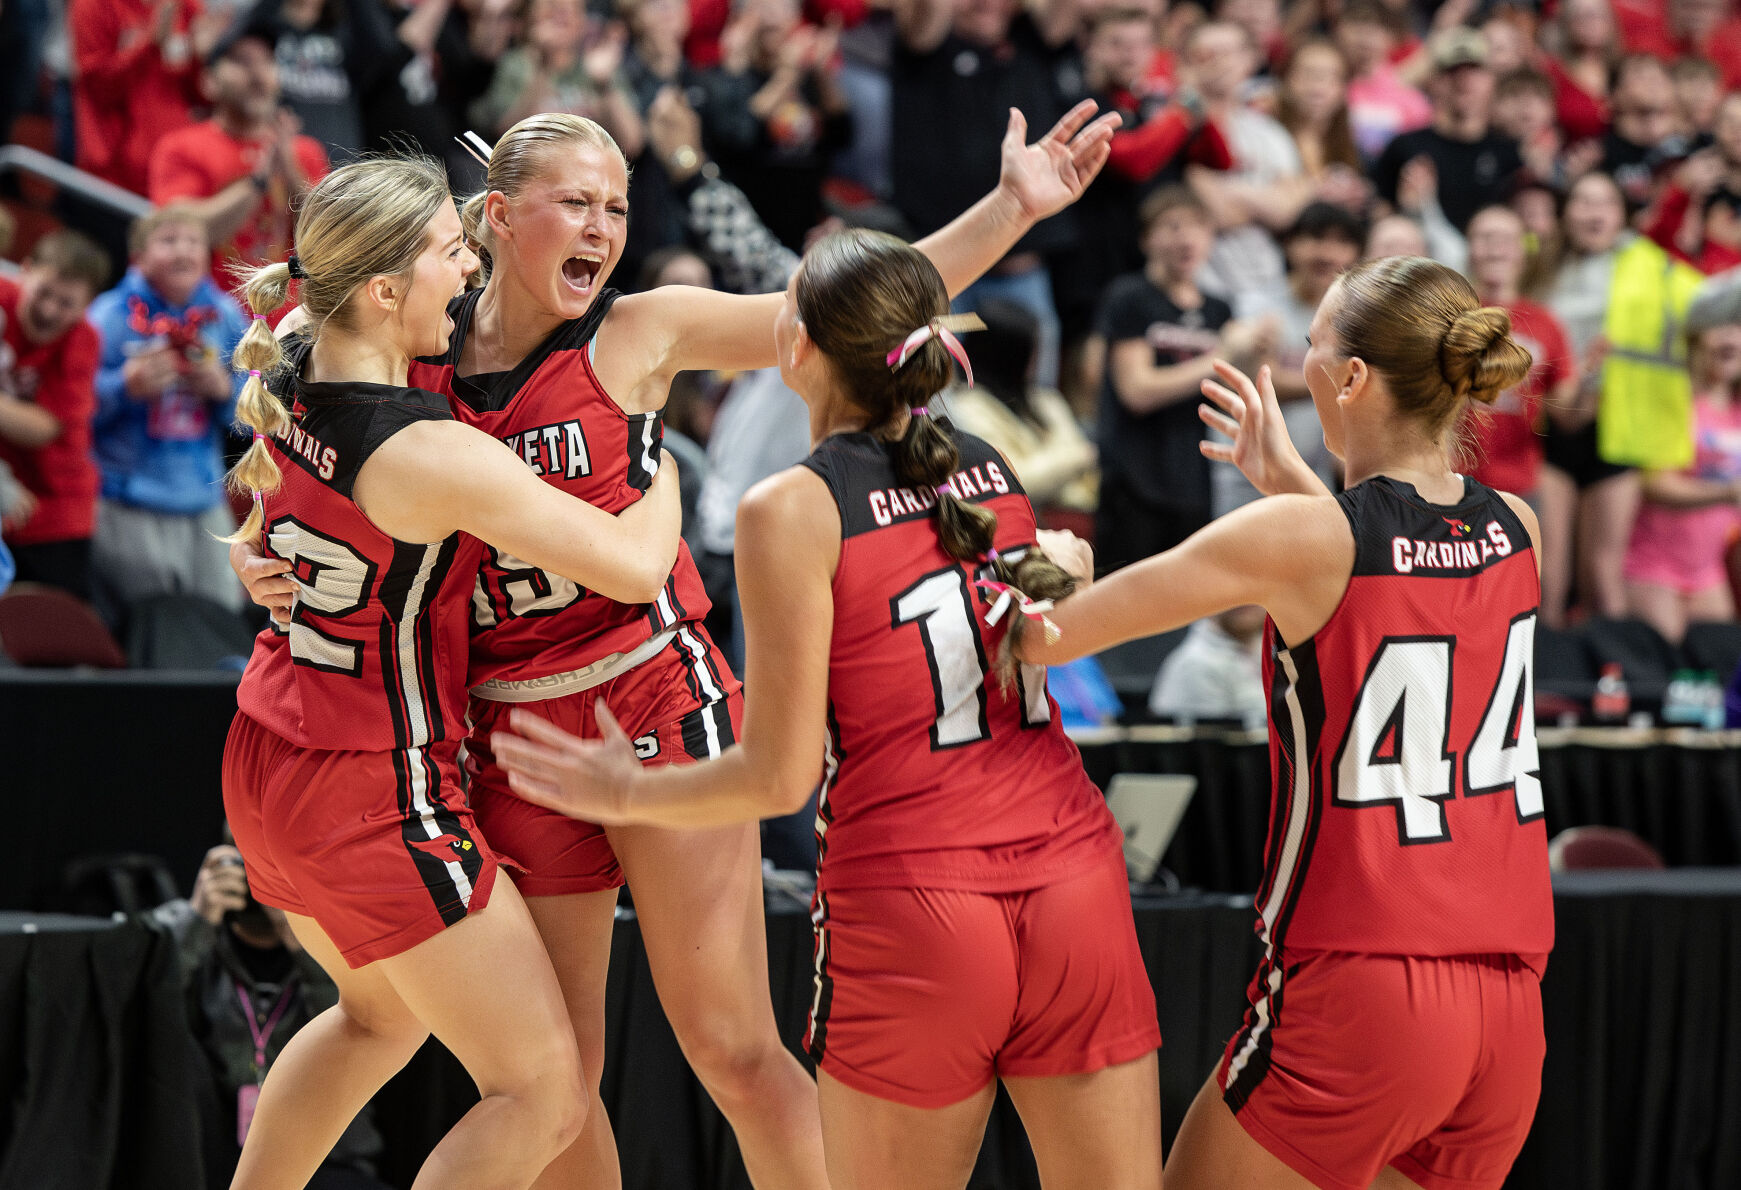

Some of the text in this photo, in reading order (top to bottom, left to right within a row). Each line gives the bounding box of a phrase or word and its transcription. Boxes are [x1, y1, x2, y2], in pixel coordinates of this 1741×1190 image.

[263, 514, 378, 679] 2
[1391, 520, 1513, 574] CARDINLS
[1331, 607, 1545, 846] 44
